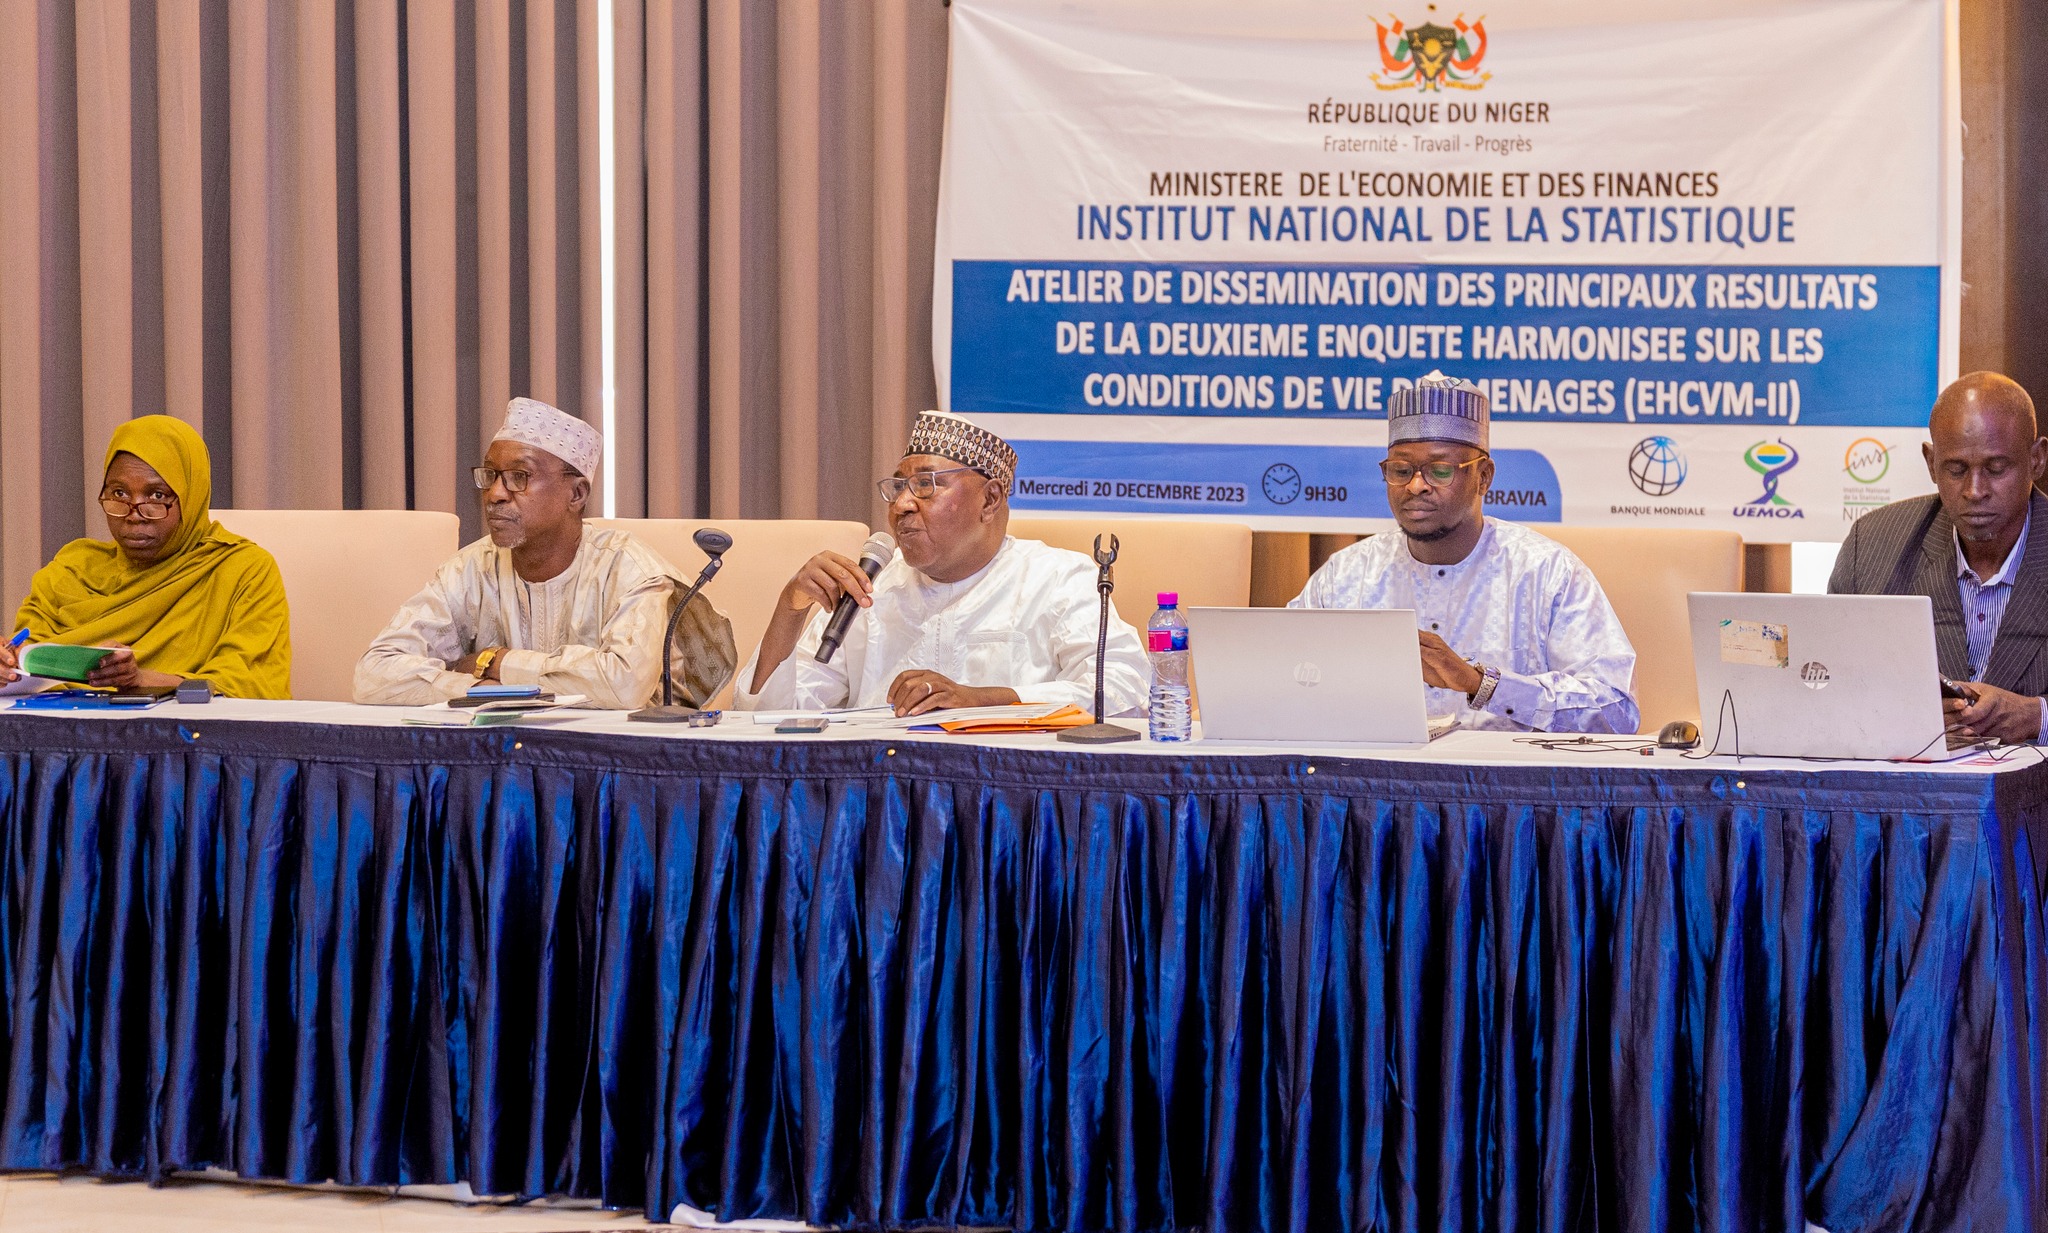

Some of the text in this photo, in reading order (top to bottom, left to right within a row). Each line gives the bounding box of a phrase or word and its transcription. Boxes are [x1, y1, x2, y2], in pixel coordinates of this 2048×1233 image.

[1308, 97, 1549, 126] RÉPUBLIQUE DU NIGER
[1323, 135, 1398, 153] Fraternité
[1413, 134, 1460, 153] Travail
[1475, 134, 1533, 157] Progrès
[1150, 170, 1719, 198] MINISTERE DE L'ECONOMIE ET DES FINANCES
[1077, 204, 1795, 249] INSTITUT NATIONAL DE LA STATISTIQUE
[1006, 269, 1878, 311] ATELIER DE DISSEMINATION DES PRINCIPAUX RESULTATS
[1056, 321, 1824, 364] DE LA DEUXIEME ENQUETE HARMONISEE SUR LES
[1083, 372, 1275, 409] CONDITIONS
[1283, 376, 1324, 410] DE
[1331, 376, 1383, 411] VIE
[1624, 379, 1801, 425] (EHCVM-II)
[1019, 479, 1245, 502] Mercredi 20 DECEMBRE 2023
[1304, 485, 1348, 502] 9H30
[1484, 490, 1547, 506] BRAVIA
[1610, 505, 1706, 517] BANQUE MONDIALE
[1733, 507, 1805, 519] UEMOA
[1294, 661, 1321, 688] hp
[1801, 661, 1830, 690] hp
